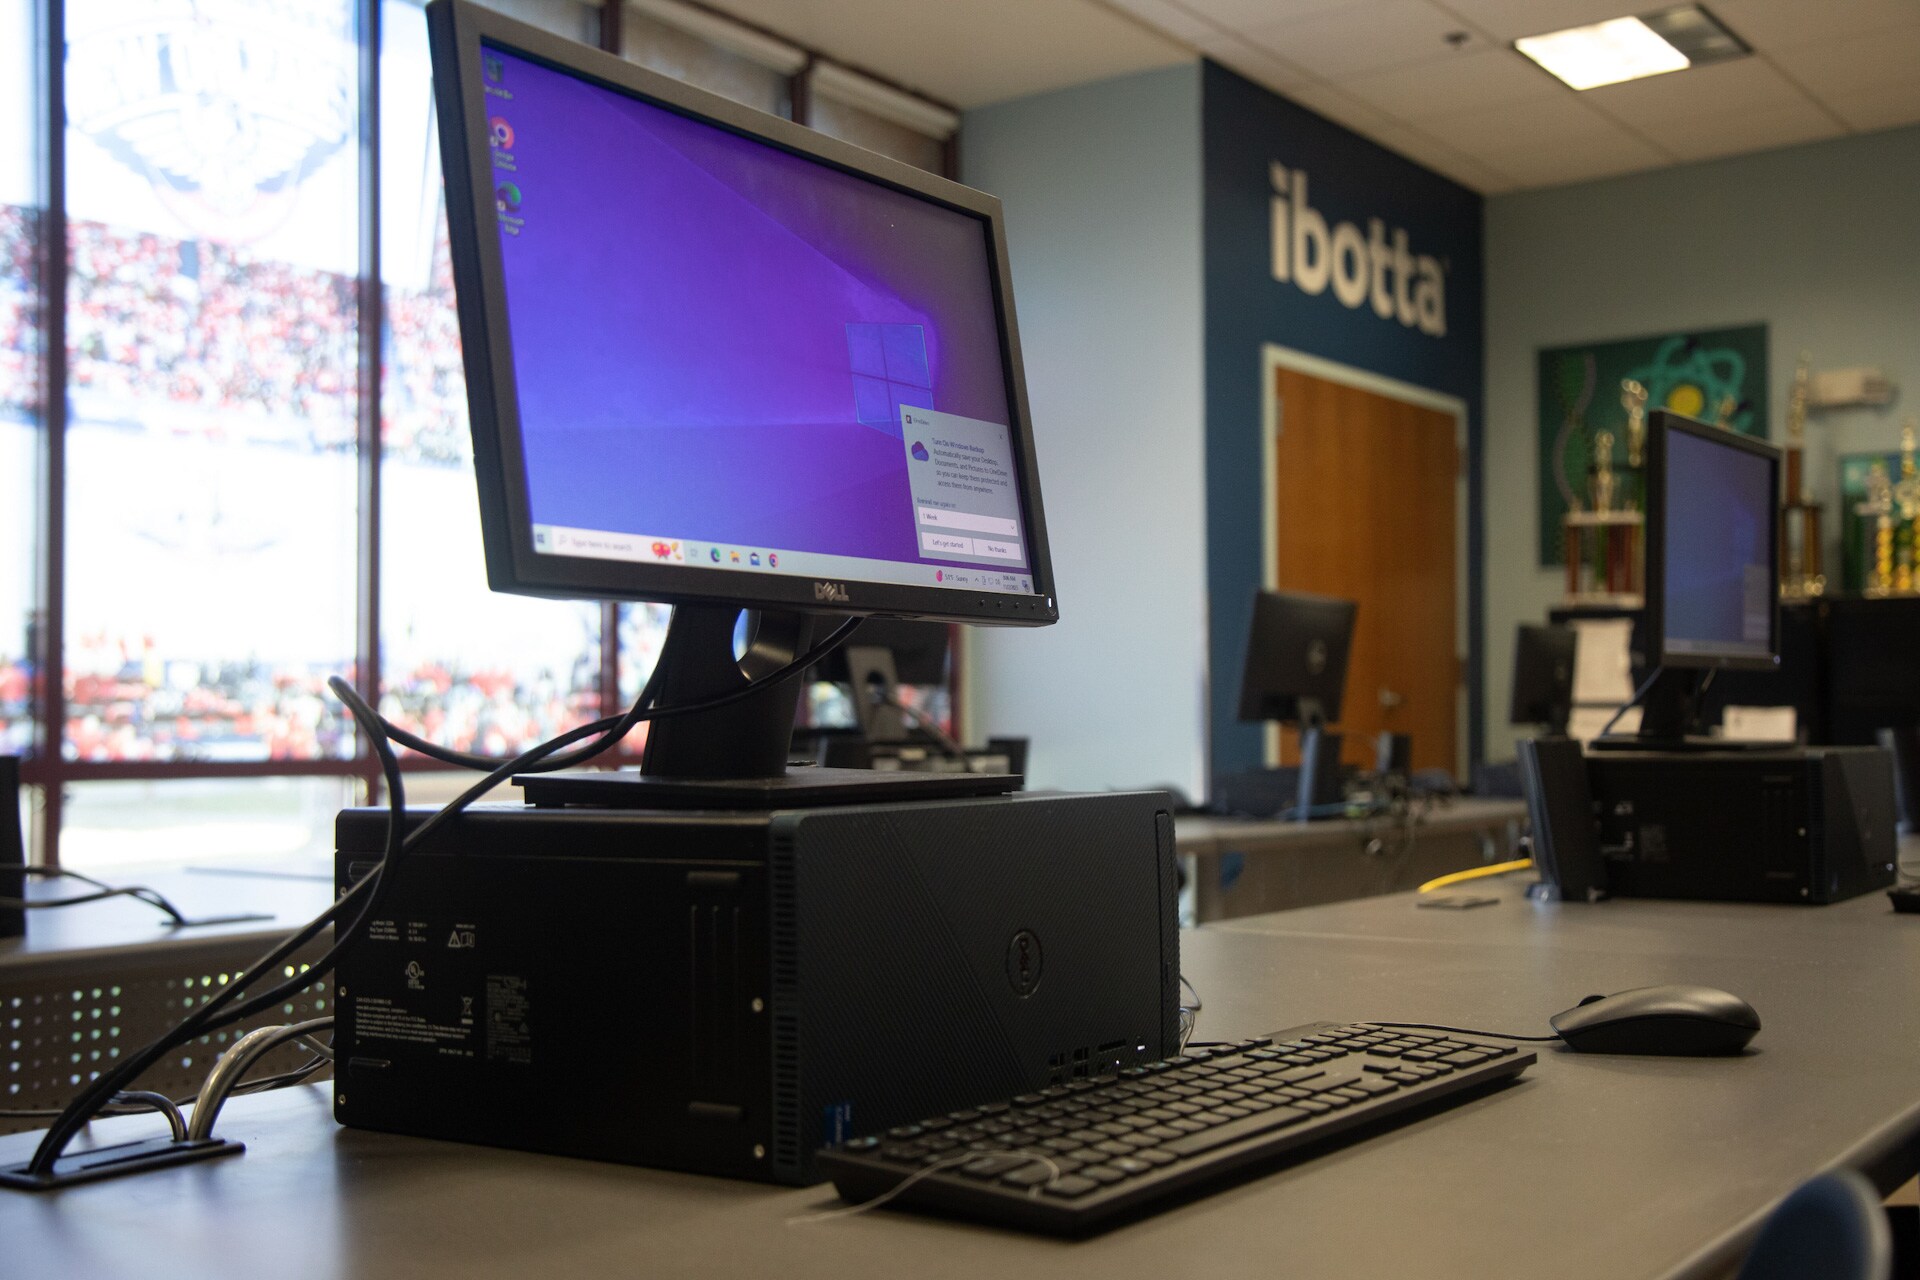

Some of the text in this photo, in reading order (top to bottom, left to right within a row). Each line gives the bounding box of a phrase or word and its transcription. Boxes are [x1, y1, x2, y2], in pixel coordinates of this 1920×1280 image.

[1270, 160, 1446, 337] ibotta
[933, 448, 961, 460] Automatically
[950, 441, 969, 451] Windows
[969, 445, 985, 454] Backup
[968, 464, 984, 473] Pictures
[938, 480, 951, 488] access
[951, 481, 962, 489] them
[959, 471, 969, 481] keep
[969, 474, 980, 482] them
[981, 477, 1000, 485] protected
[815, 582, 849, 601] DELL
